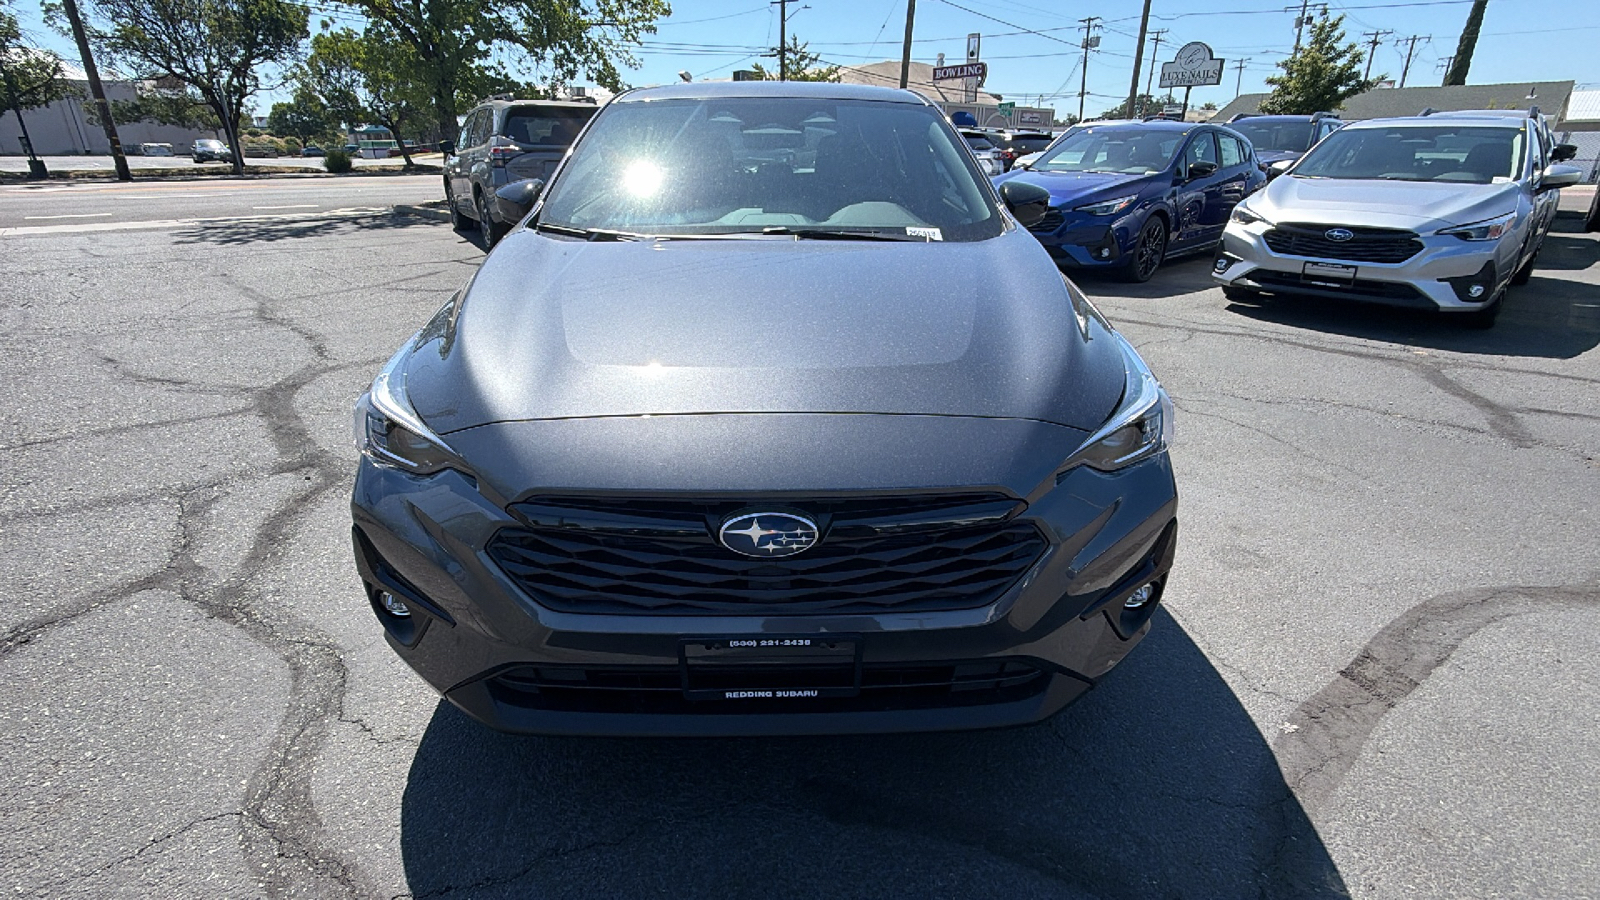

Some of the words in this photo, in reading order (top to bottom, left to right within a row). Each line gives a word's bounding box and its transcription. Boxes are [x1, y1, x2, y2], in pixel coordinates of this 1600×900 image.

[935, 65, 982, 79] BOWLING
[1162, 71, 1187, 81] LUXE
[1188, 69, 1218, 79] NAILS
[729, 639, 757, 647] (530)
